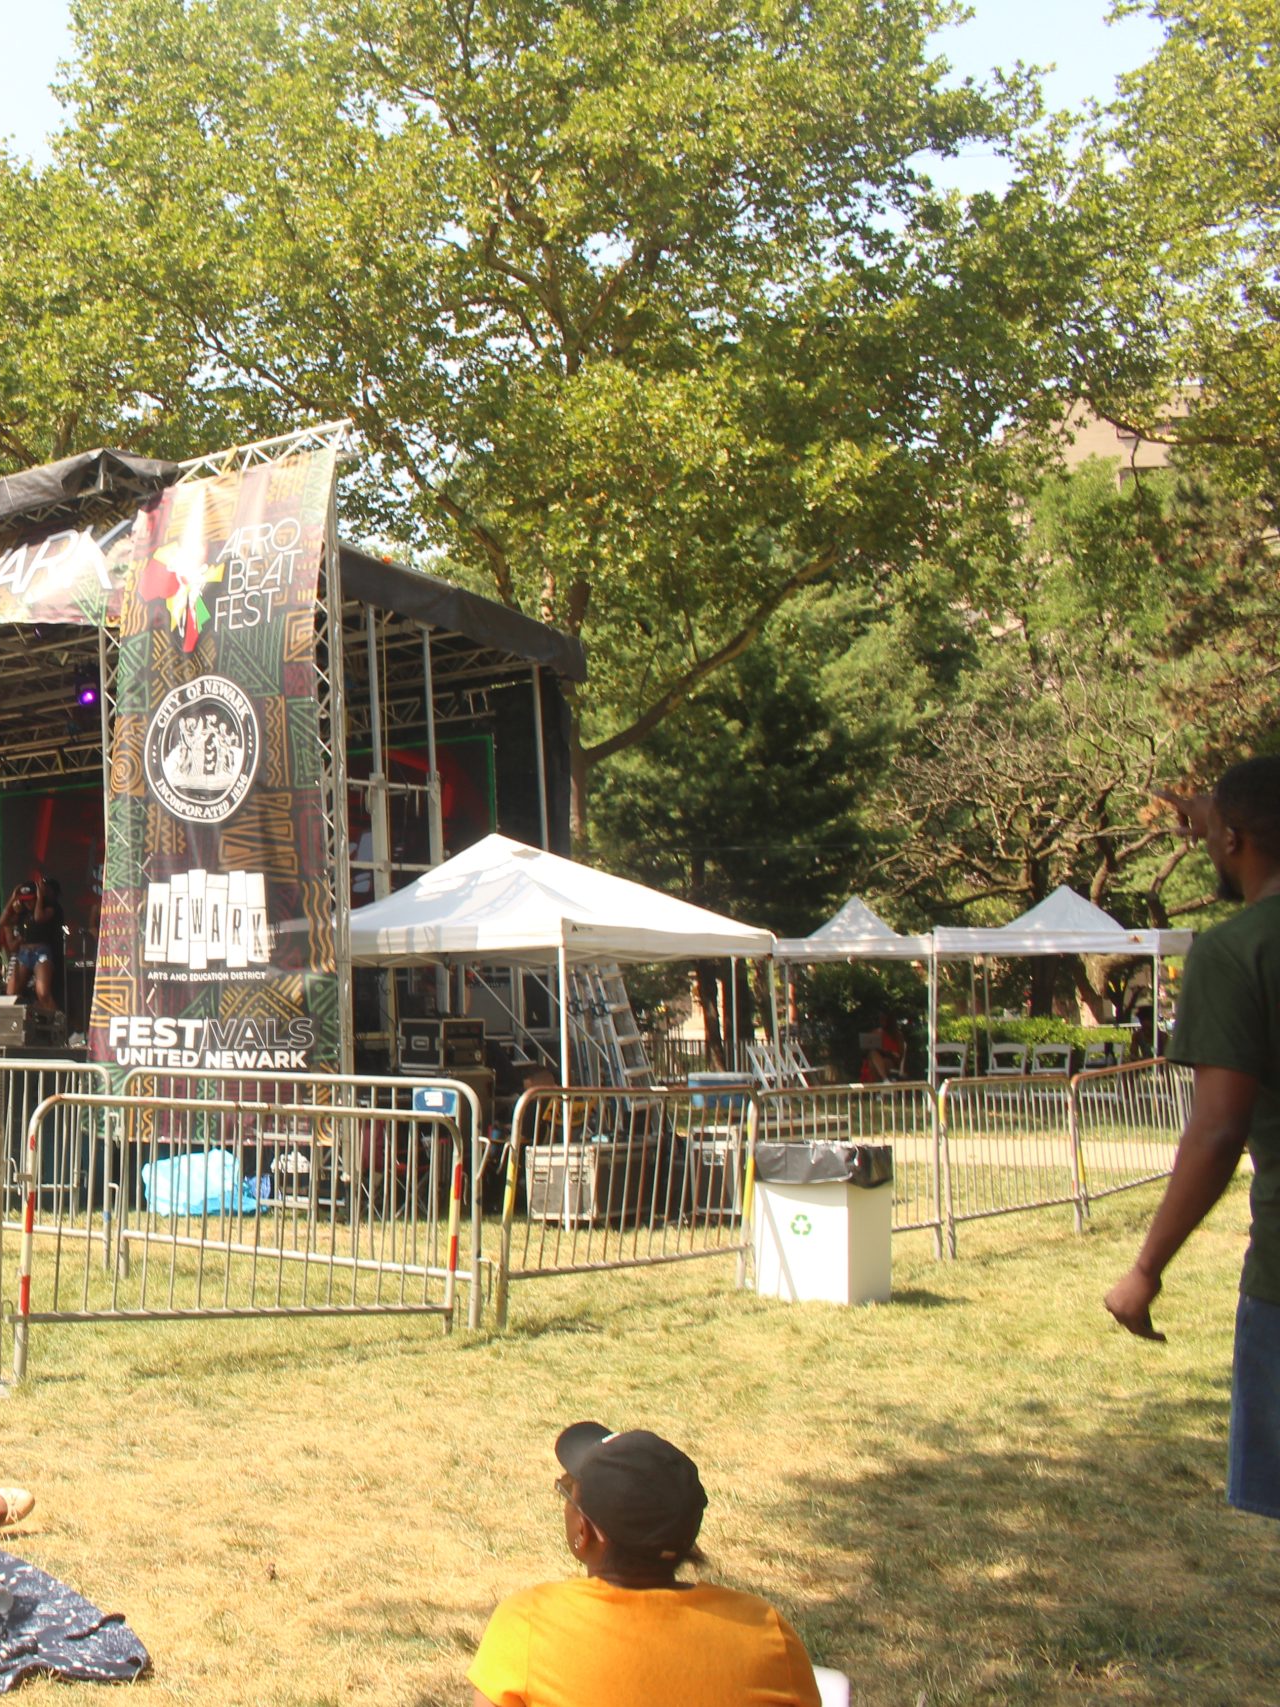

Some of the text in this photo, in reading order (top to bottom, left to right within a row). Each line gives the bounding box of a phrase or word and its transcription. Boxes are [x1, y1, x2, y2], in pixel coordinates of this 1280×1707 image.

[216, 517, 301, 563] AFRO
[228, 548, 303, 595] BEAT
[214, 587, 280, 633] FEST
[157, 680, 250, 728] CITY OF NEWARK
[155, 772, 249, 818] INCORPORATED 1836
[150, 896, 264, 959] NEWARK
[147, 970, 267, 982] ARTS AND EDUCATION DISTRICT
[108, 1016, 315, 1050] FESTIVALS
[116, 1049, 308, 1069] UNITED NEWARK
